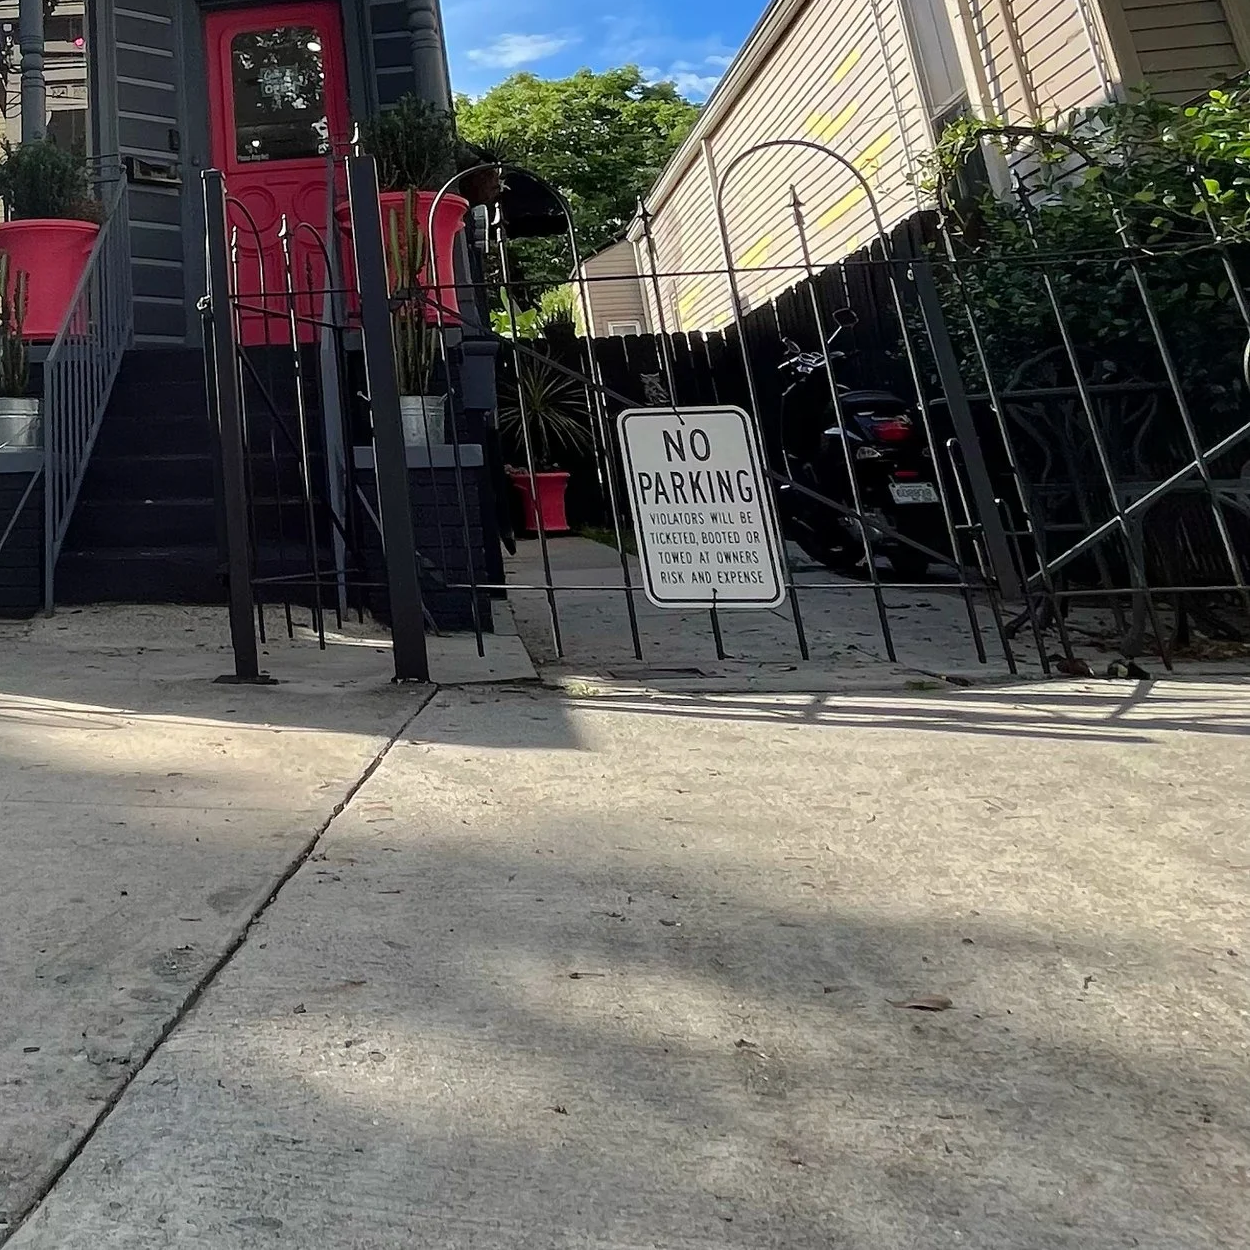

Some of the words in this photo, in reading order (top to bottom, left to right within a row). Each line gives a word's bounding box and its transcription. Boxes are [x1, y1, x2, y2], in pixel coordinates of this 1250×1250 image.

[662, 428, 711, 462] NO
[638, 470, 753, 504] PARKING
[650, 512, 704, 525] VIOLATORS
[710, 512, 734, 525] WILL
[740, 511, 754, 524] BE
[650, 532, 699, 546] TICKETED,
[702, 532, 740, 544] BOOTED
[747, 532, 760, 544] OR
[658, 552, 692, 564] TOWED
[700, 552, 710, 564] AT
[716, 551, 759, 564] OWNERS
[660, 571, 684, 584] RISK
[691, 571, 712, 584] AND
[717, 571, 764, 584] EXPENSE
